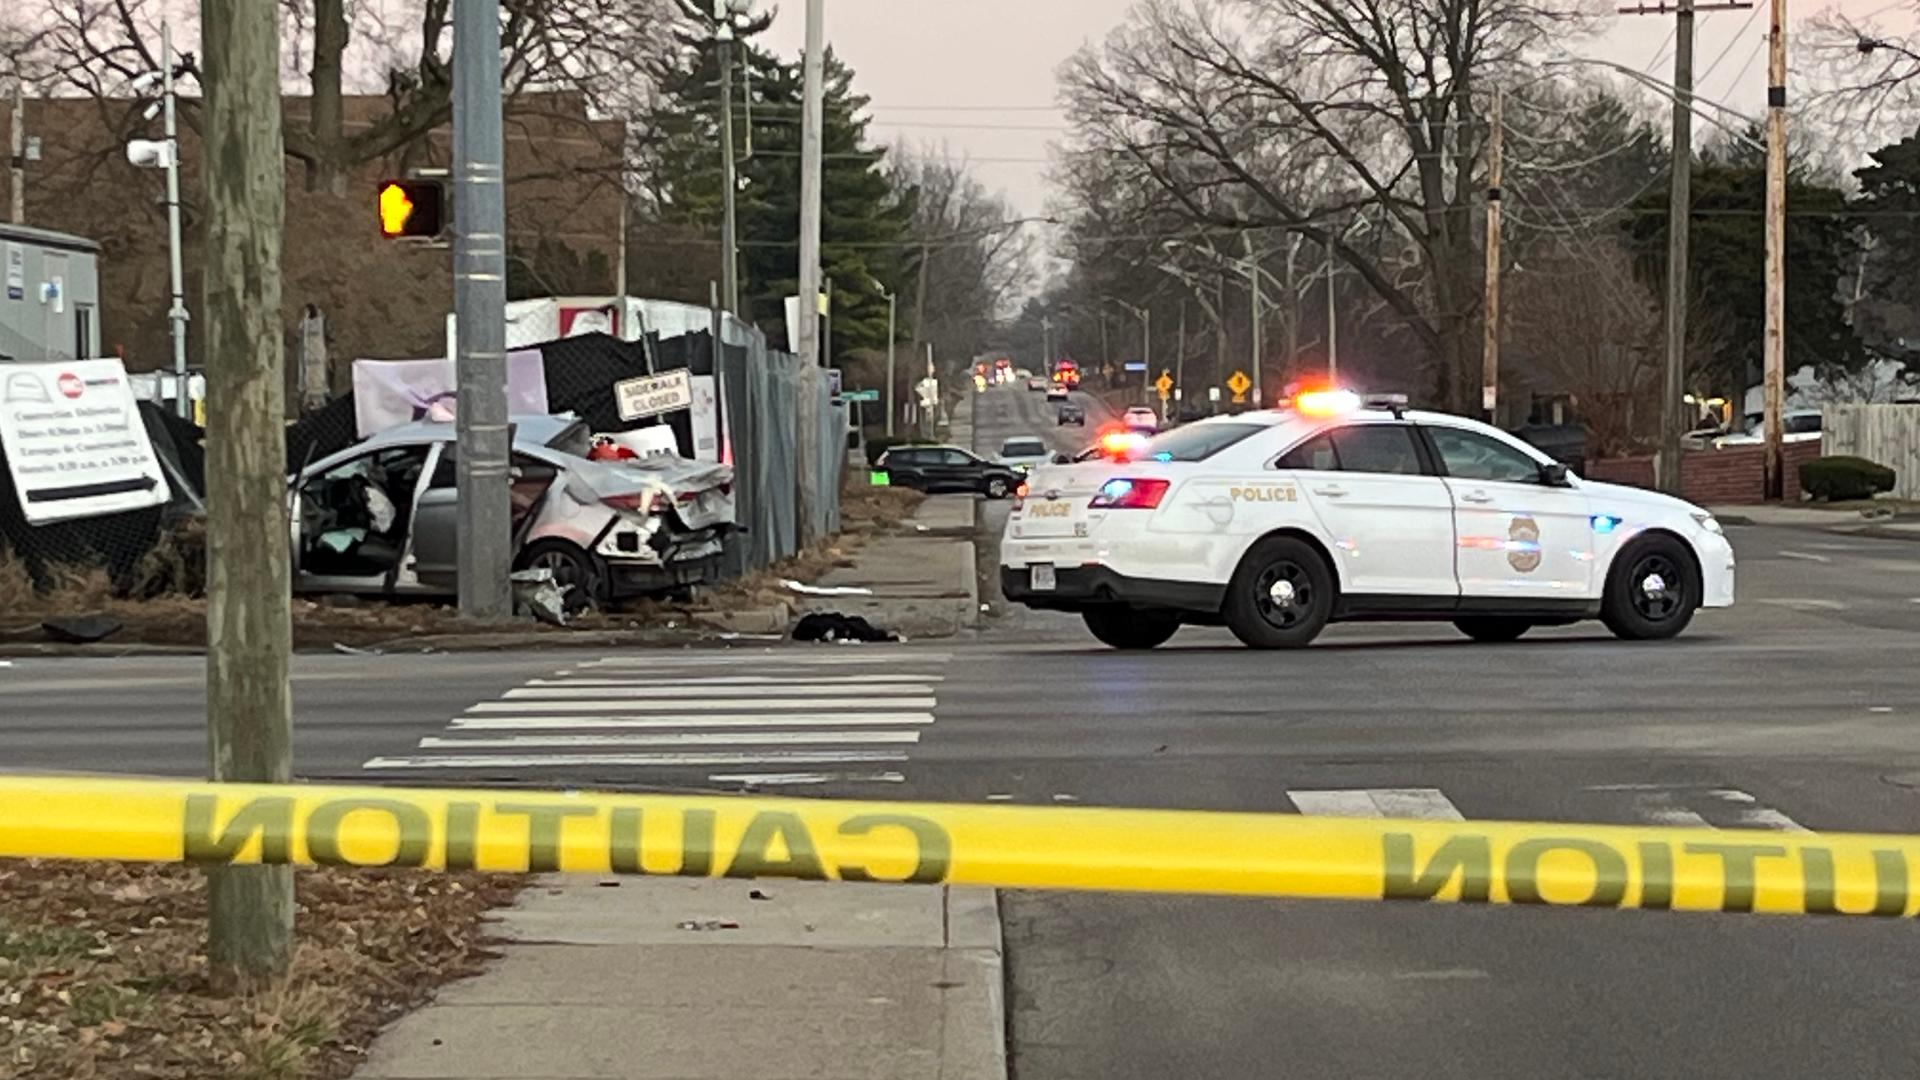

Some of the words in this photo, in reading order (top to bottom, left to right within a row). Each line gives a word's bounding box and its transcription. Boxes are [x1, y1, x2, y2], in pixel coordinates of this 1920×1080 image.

[624, 376, 682, 397] SIDEWALK
[632, 392, 680, 412] CLOSED
[1230, 487, 1298, 502] POLICE
